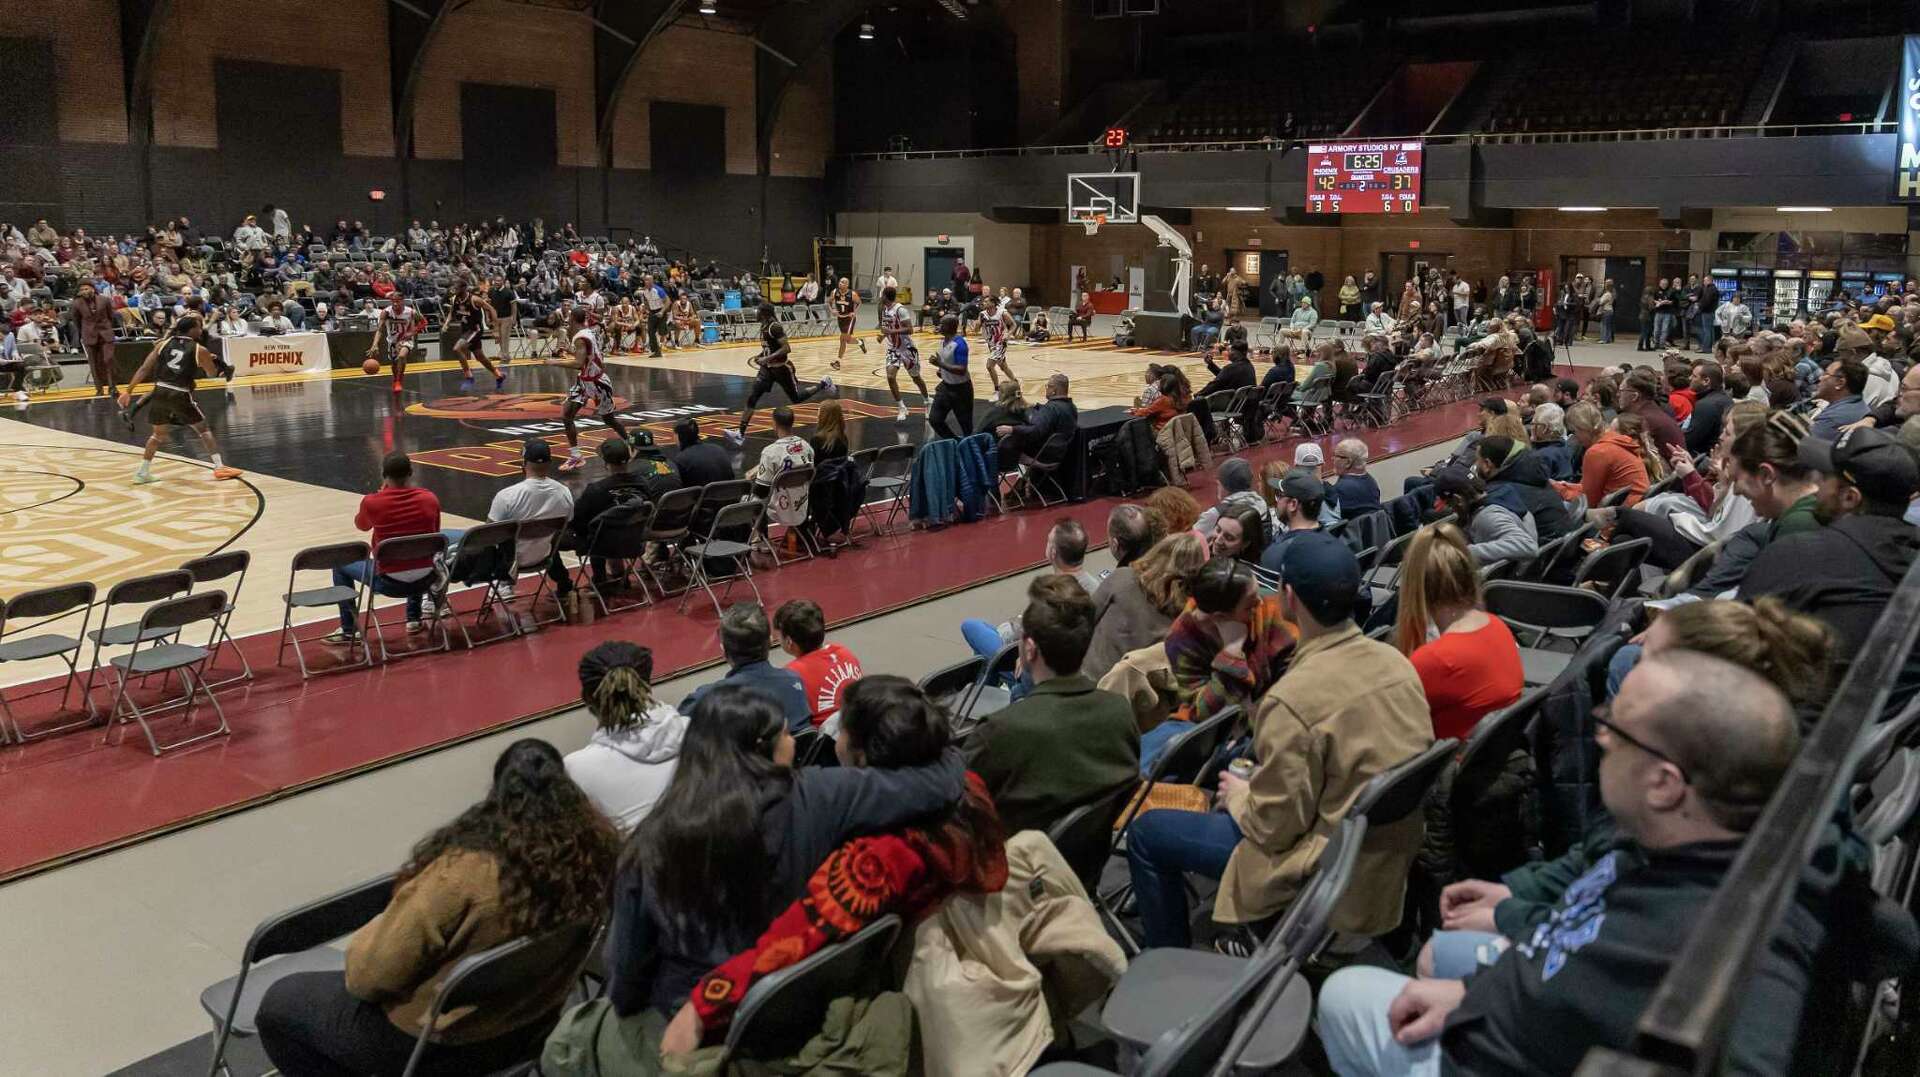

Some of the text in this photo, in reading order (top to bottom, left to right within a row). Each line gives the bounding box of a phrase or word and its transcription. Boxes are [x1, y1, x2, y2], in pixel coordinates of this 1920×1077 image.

[1106, 128, 1124, 146] 23
[1327, 143, 1401, 153] ARMORY STUDIOS NY
[1353, 155, 1380, 169] 6:25
[1313, 168, 1338, 176] PHOENIX
[1383, 166, 1419, 174] CRUSADERS
[1319, 176, 1335, 190] 42
[1359, 181, 1366, 192] 2
[1394, 175, 1411, 190] 37
[1316, 201, 1322, 212] 3
[1333, 201, 1339, 212] 5
[1384, 200, 1391, 212] 6
[1405, 200, 1412, 212] 0
[166, 348, 184, 370] 2
[249, 350, 304, 368] PHOENIX
[817, 660, 862, 714] WILLIAMS
